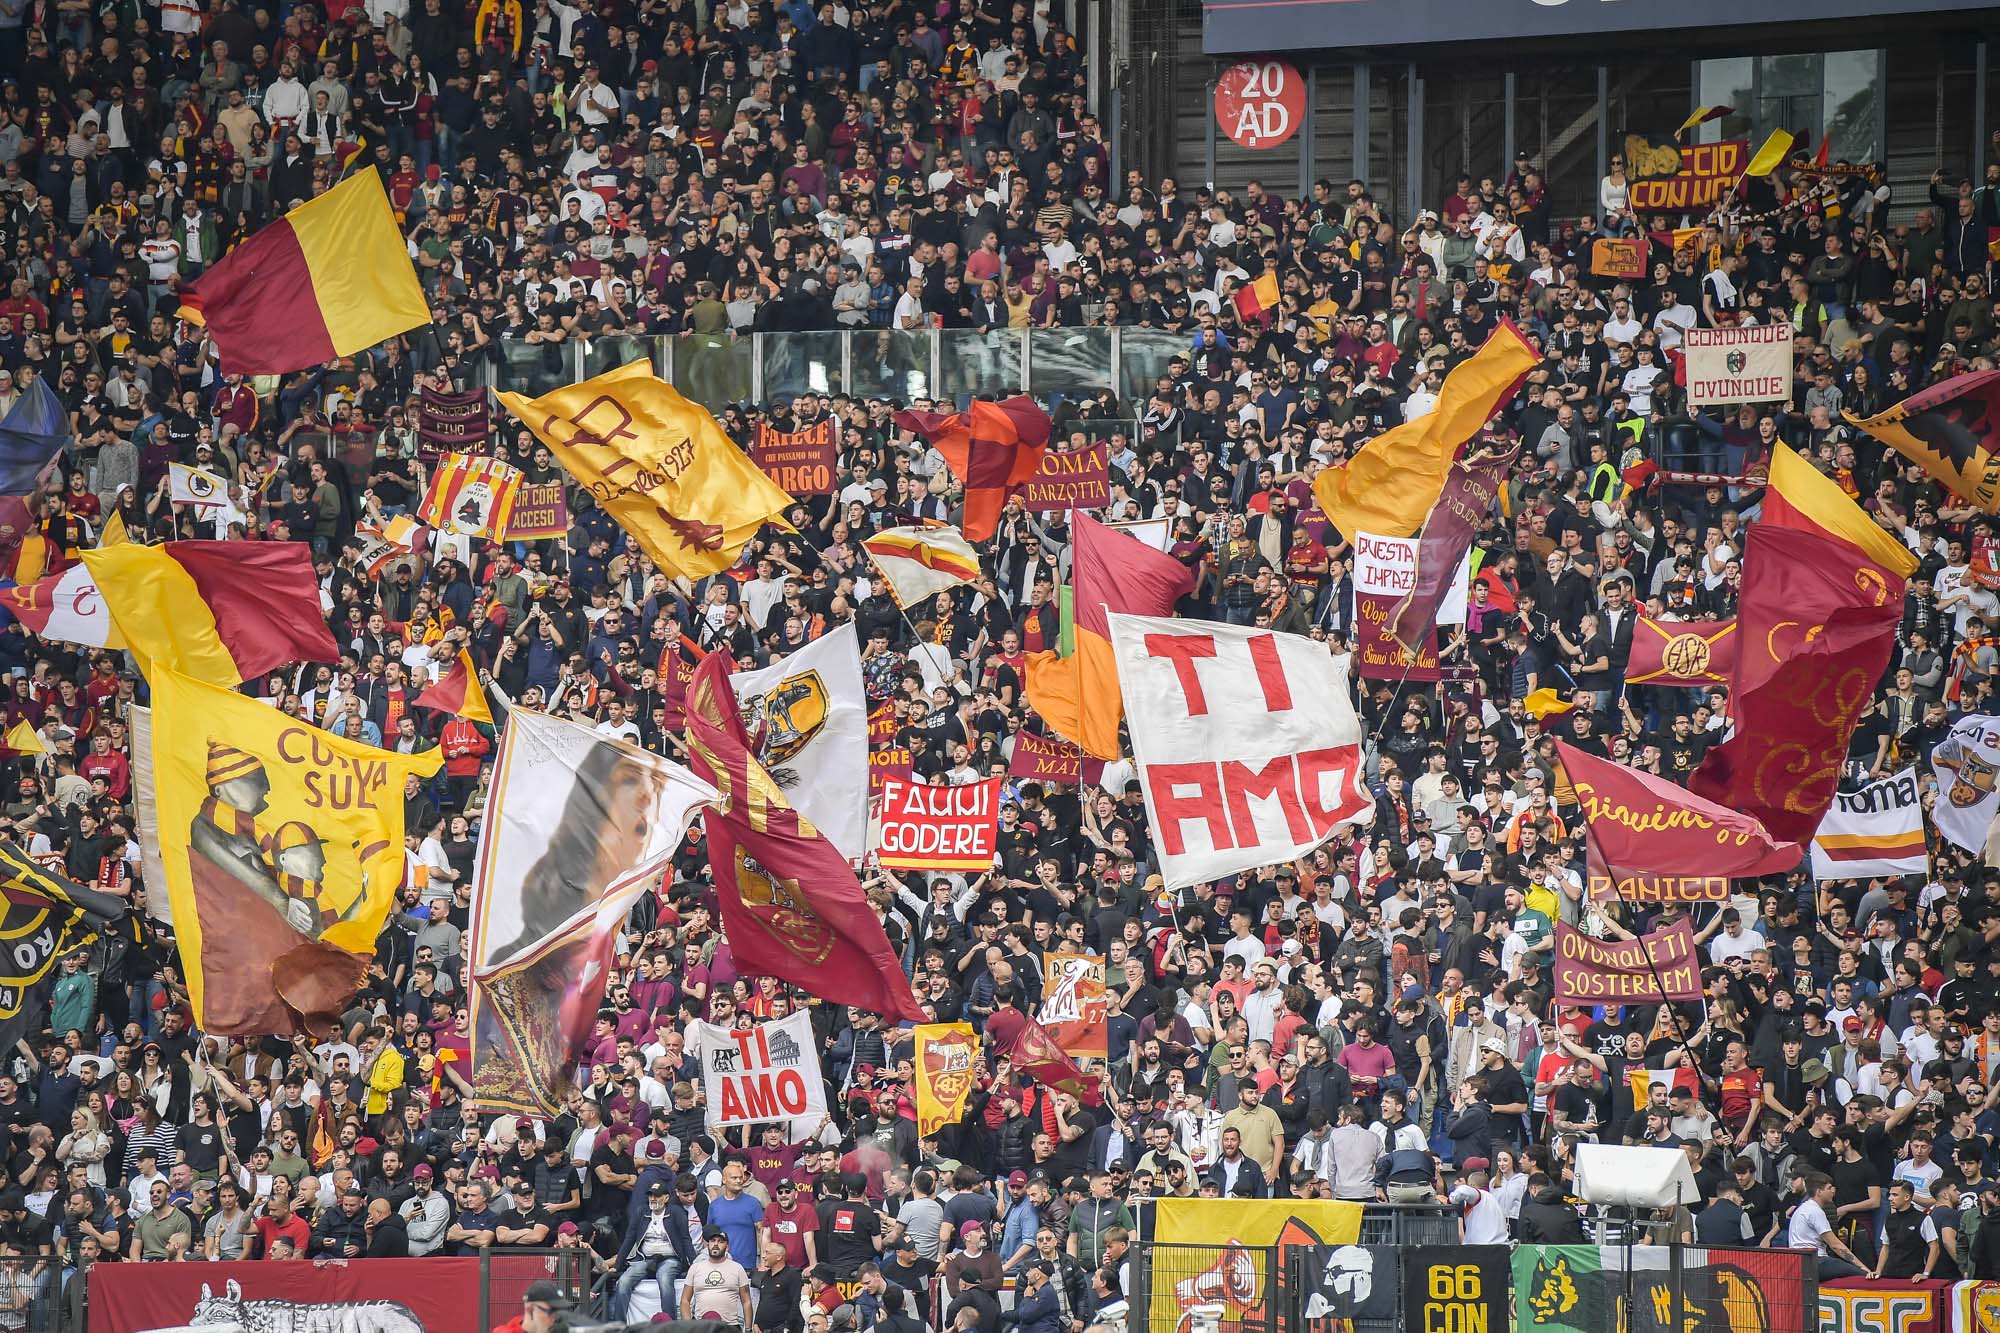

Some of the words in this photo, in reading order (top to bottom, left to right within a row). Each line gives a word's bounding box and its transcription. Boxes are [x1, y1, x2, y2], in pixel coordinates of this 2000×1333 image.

[1241, 62, 1284, 98] 20
[1234, 102, 1289, 138] AD
[1630, 181, 1687, 208] CON
[1687, 324, 1789, 346] COMUNQUE
[1694, 377, 1783, 398] OVUNQUE
[1035, 450, 1104, 476] OMA
[760, 464, 830, 492] ARGO
[1028, 480, 1106, 502] BARZOTTA
[1671, 472, 1767, 486] BOYS
[532, 486, 561, 506] CORE
[512, 509, 555, 529] ACCESO
[1144, 633, 1293, 716] TI
[879, 720, 894, 734] TE
[1021, 737, 1057, 757] MAI
[1033, 758, 1080, 776] MAI
[1146, 743, 1371, 856] AMO
[1837, 776, 1918, 814] roma
[880, 822, 990, 855] GODERE
[1589, 876, 1727, 901] PANICO
[1562, 933, 1660, 968] OVUNQUE
[1663, 931, 1688, 960] TI
[730, 1026, 771, 1070] TI
[721, 1069, 807, 1121] AMO
[758, 1159, 782, 1169] ROMA
[1428, 1264, 1481, 1300] 66
[1423, 1302, 1488, 1333] CON
